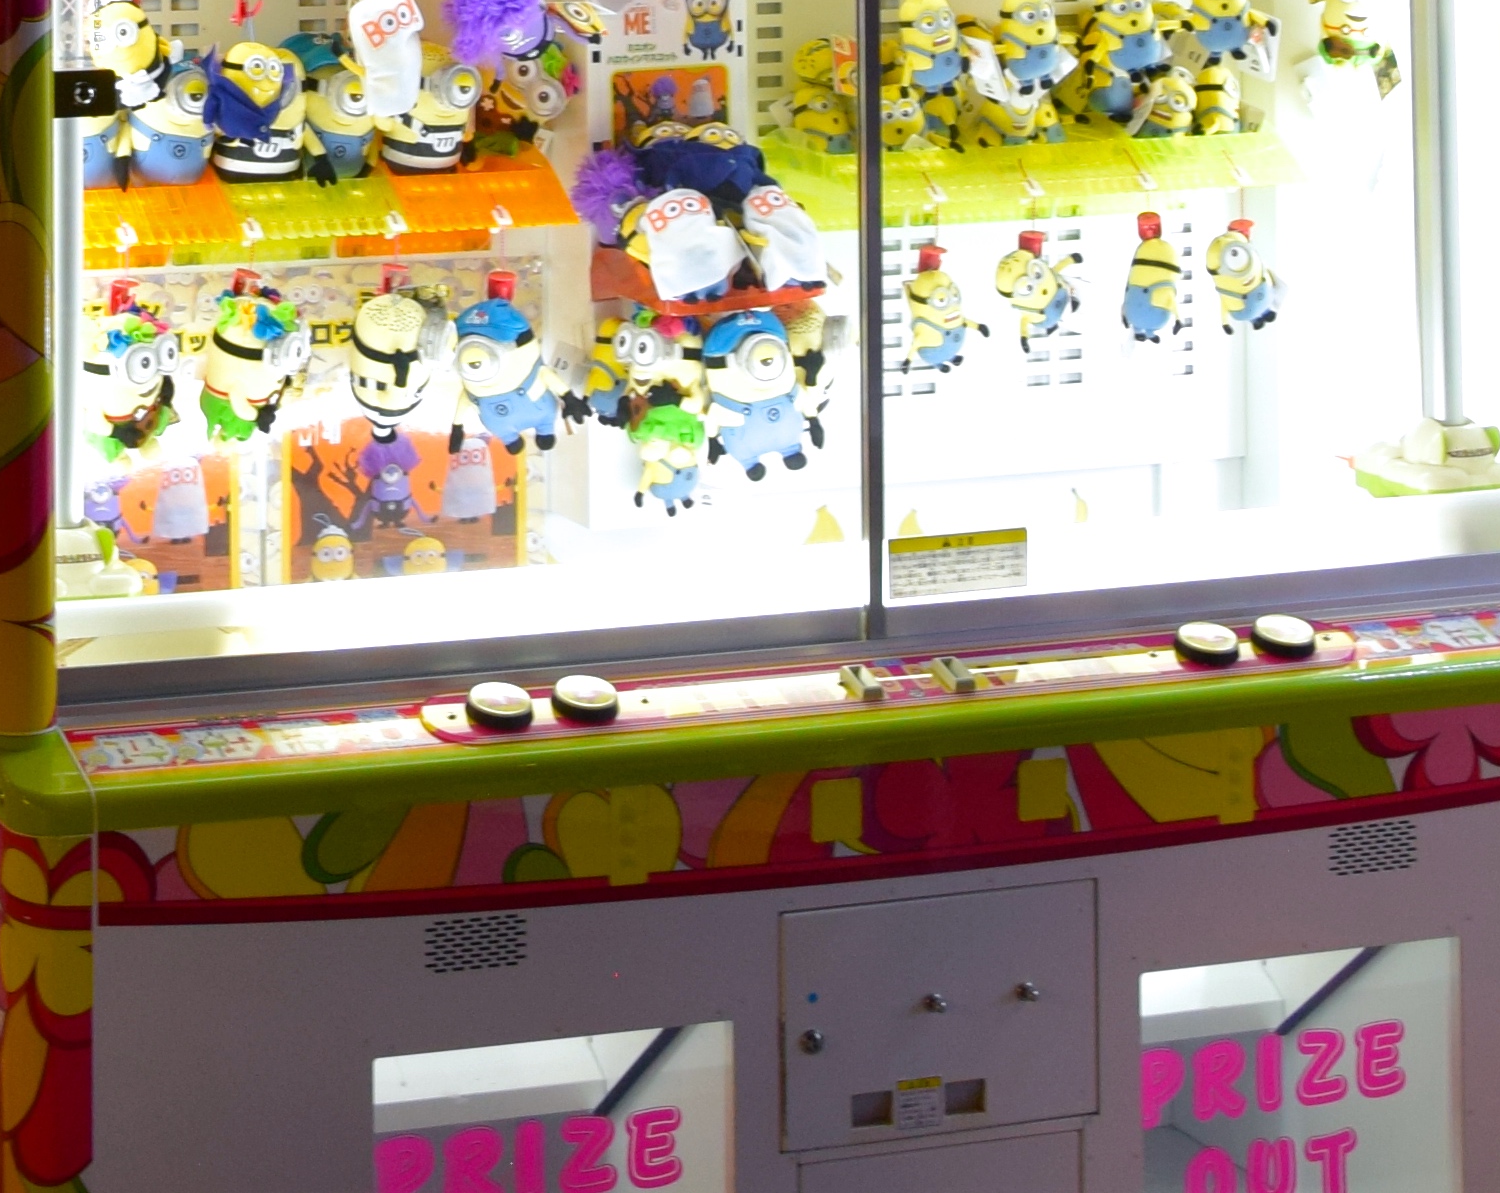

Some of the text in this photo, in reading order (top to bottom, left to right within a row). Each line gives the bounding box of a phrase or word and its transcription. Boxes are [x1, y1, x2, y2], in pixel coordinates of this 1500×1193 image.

[624, 13, 651, 36] ME
[1140, 1018, 1406, 1130] PRIZE
[374, 1104, 683, 1193] PRIZE
